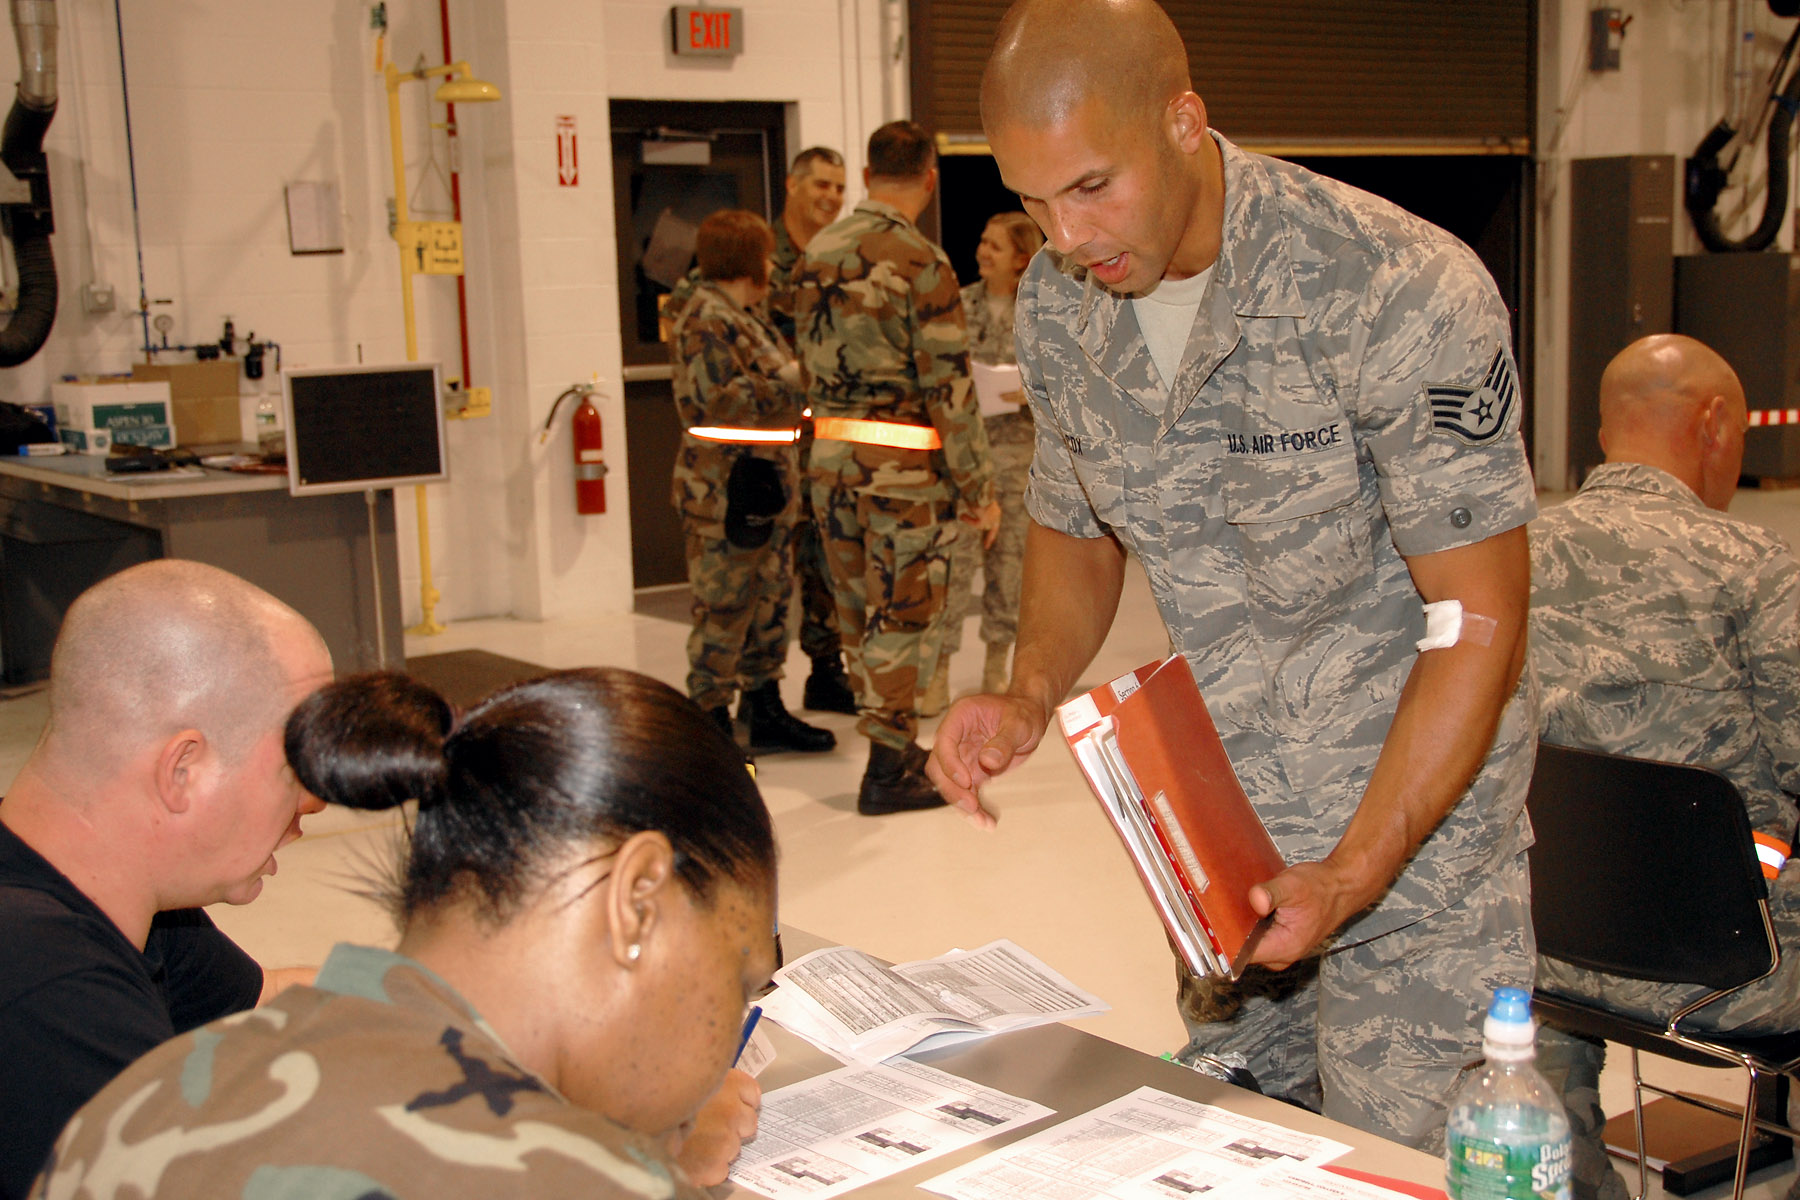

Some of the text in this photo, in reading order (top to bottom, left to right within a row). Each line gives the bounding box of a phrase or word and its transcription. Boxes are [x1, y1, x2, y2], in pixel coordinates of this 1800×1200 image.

[689, 11, 732, 49] EXIT
[1227, 423, 1342, 455] U.S. AIR FORCE
